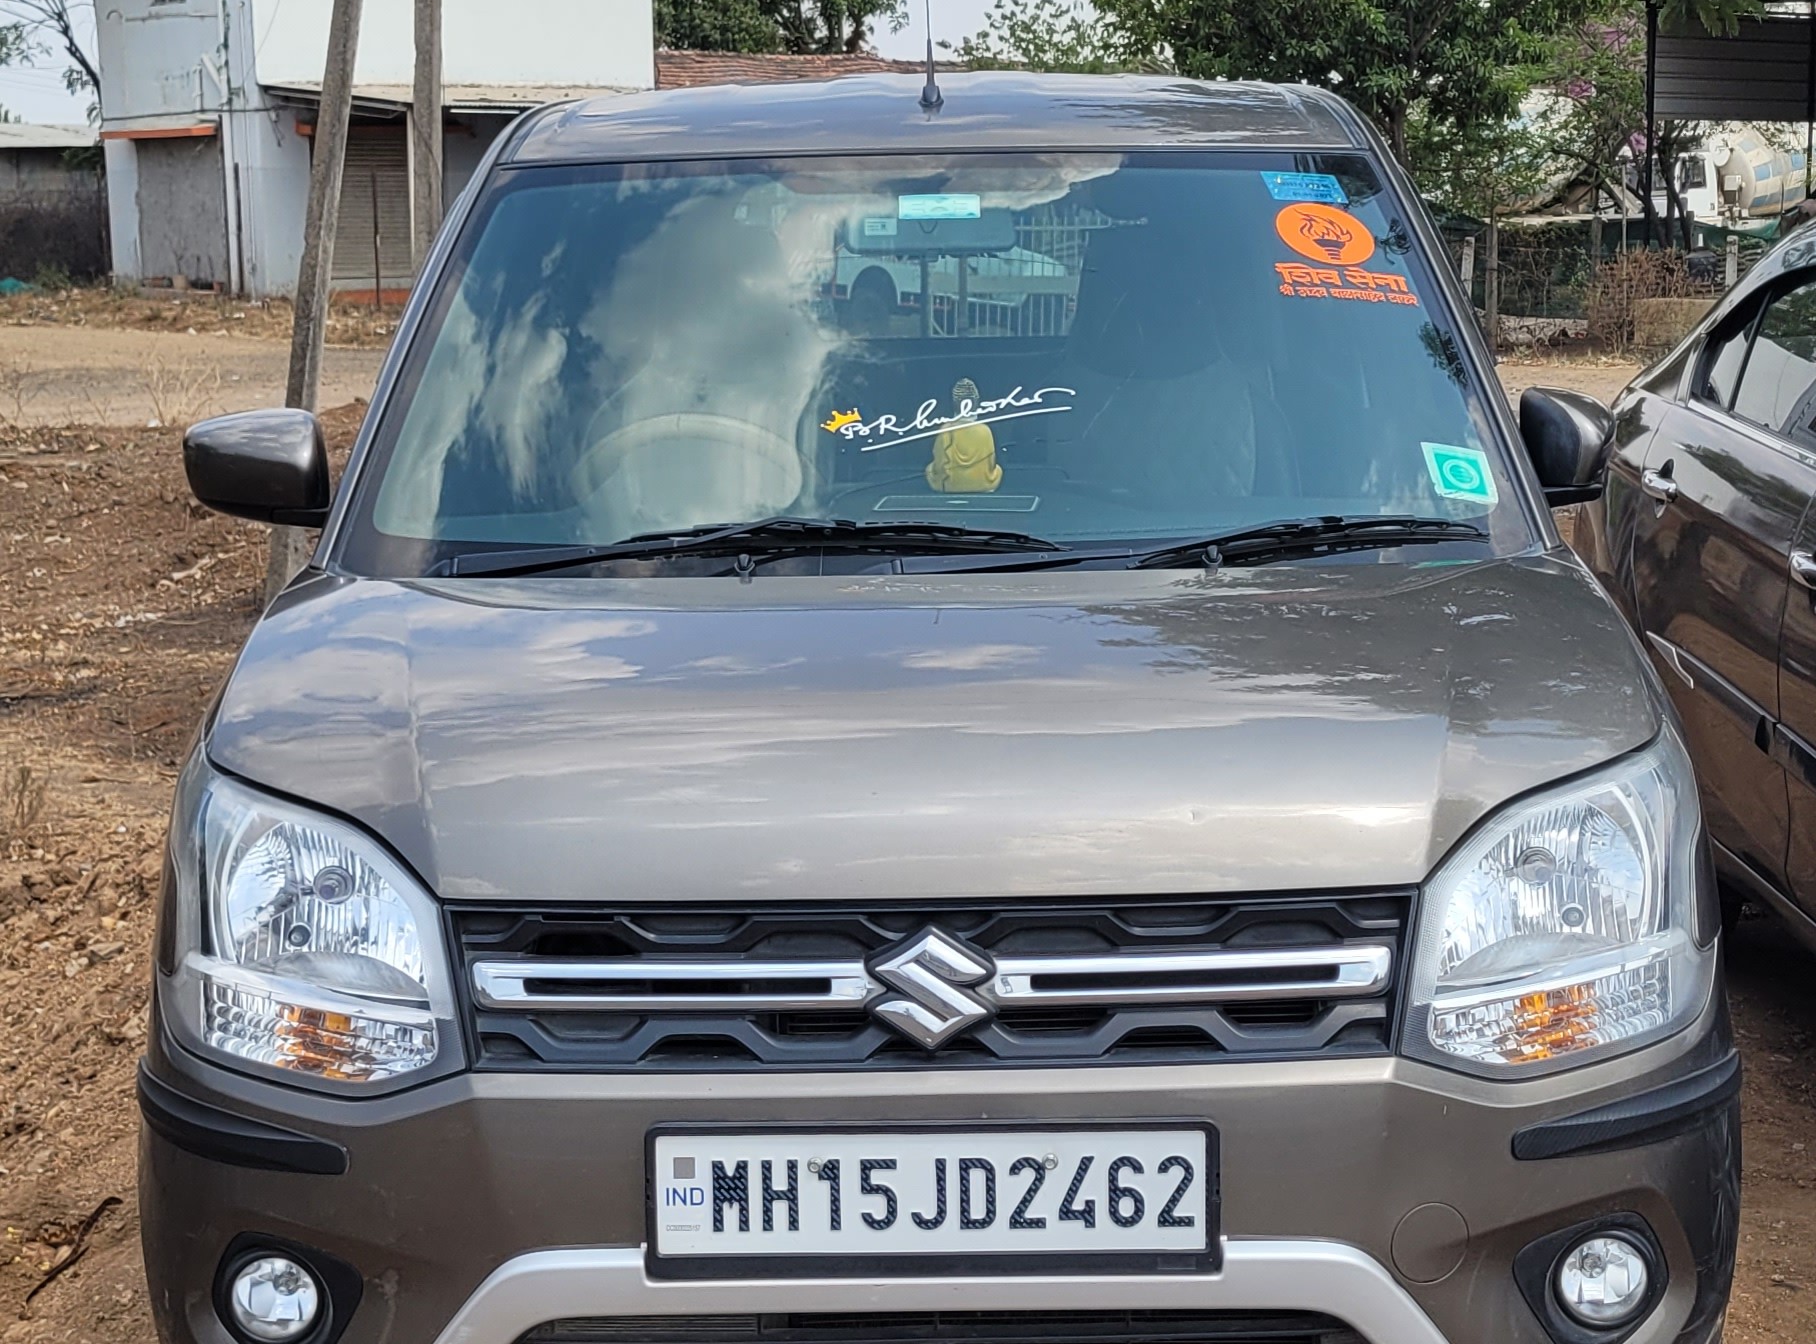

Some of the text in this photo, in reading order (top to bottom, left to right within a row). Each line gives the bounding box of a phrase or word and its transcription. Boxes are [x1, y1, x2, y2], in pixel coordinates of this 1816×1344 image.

[1274, 262, 1408, 292] शिव सेना
[665, 1155, 1196, 1233] IND MH15JD2462
